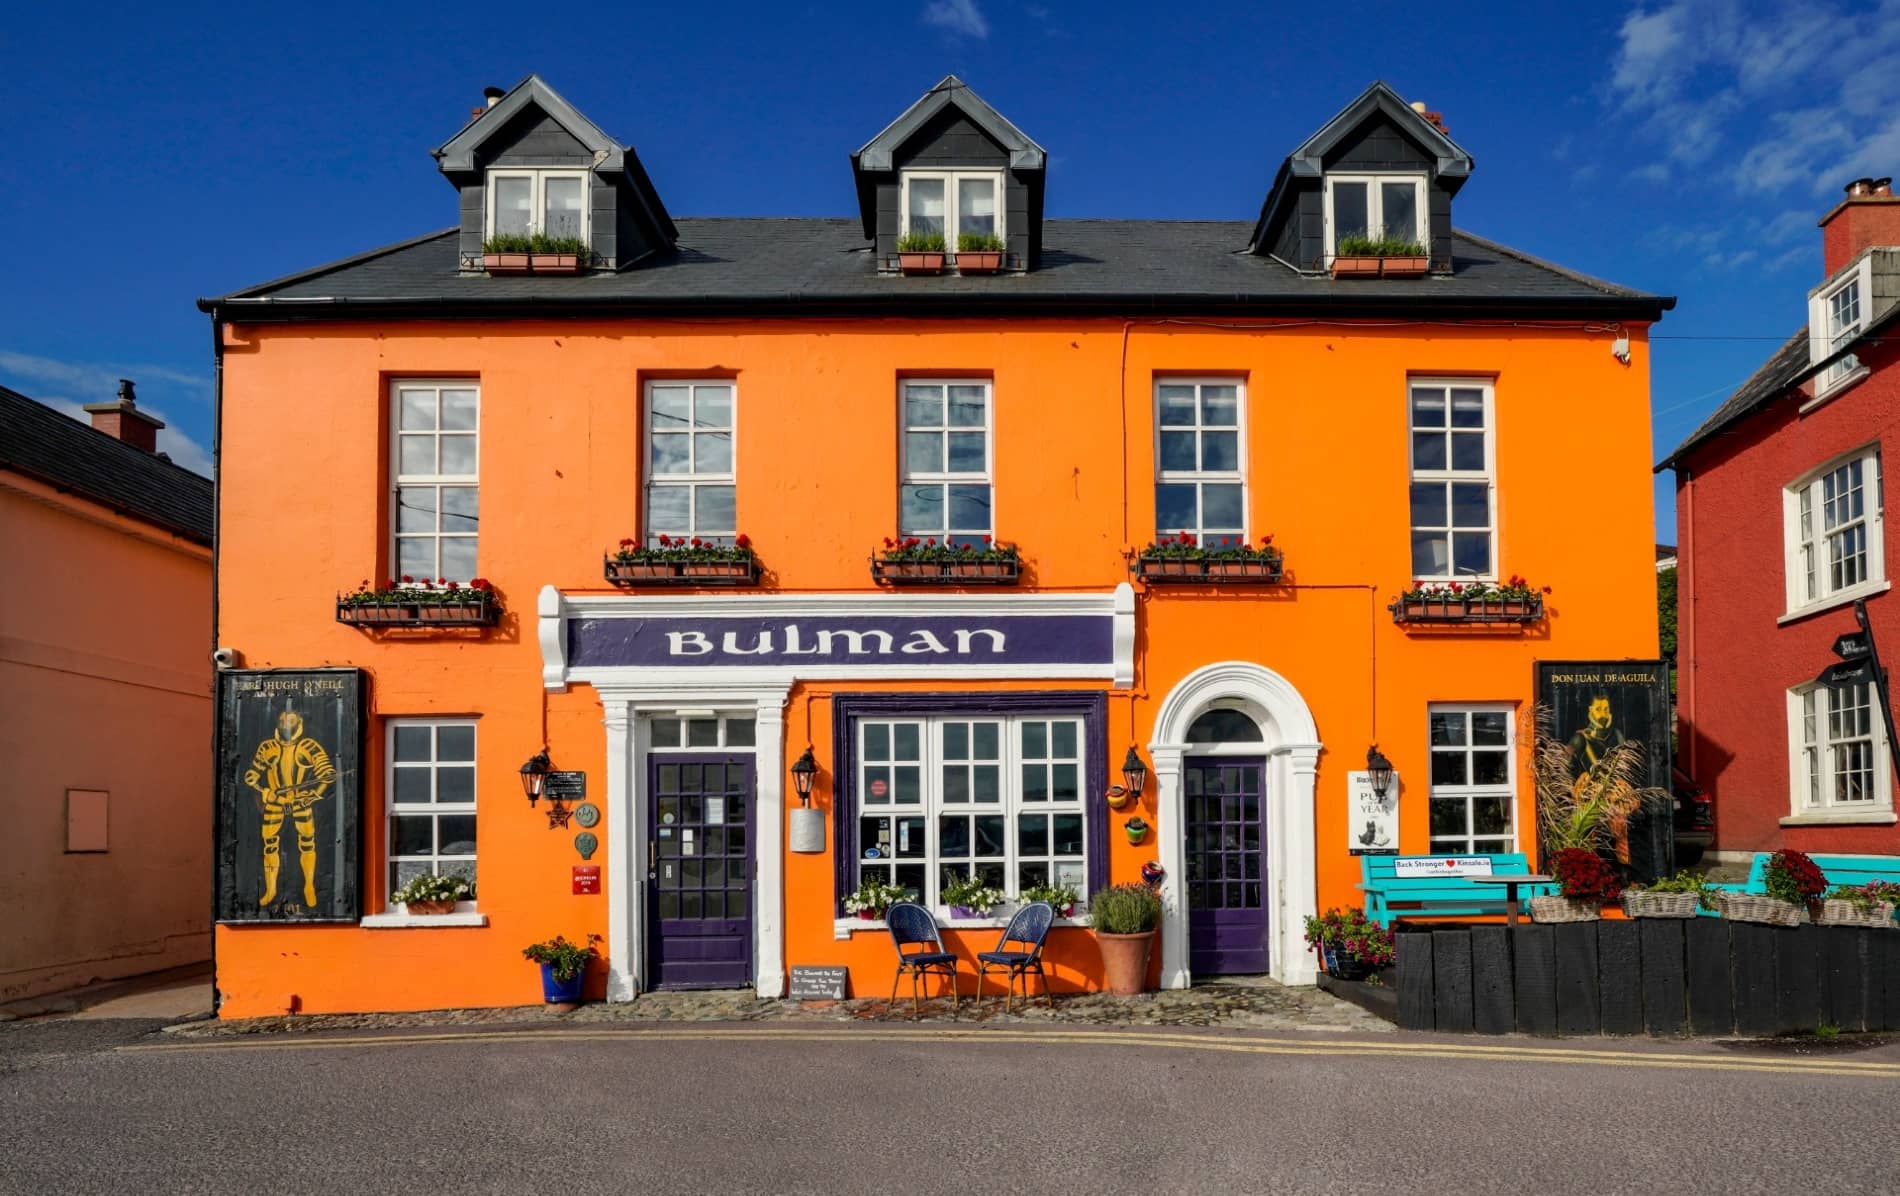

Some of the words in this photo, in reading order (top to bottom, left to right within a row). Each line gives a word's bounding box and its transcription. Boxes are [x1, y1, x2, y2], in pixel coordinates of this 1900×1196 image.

[665, 623, 1006, 657] Bulman
[1551, 674, 1573, 683] DON
[267, 681, 299, 690] HUGH
[303, 680, 344, 689] O'NEILL
[1360, 805, 1390, 816] YEAR
[1414, 860, 1445, 868] Stronger
